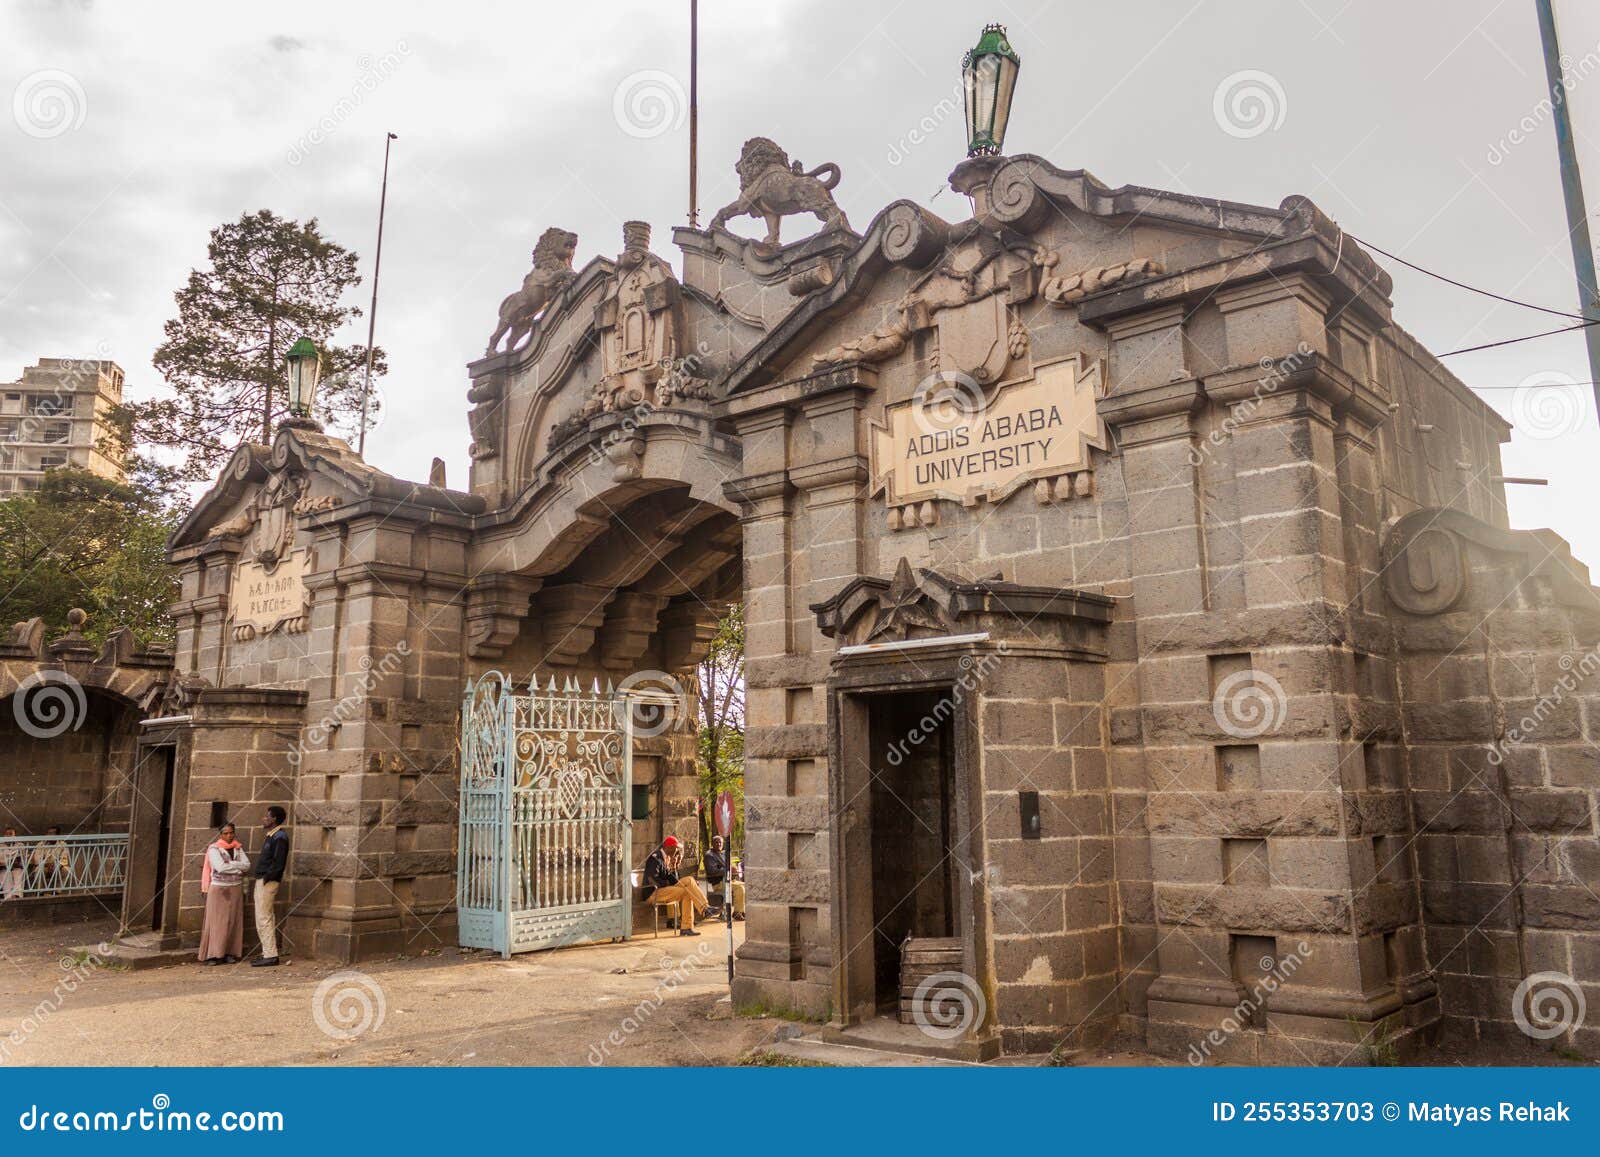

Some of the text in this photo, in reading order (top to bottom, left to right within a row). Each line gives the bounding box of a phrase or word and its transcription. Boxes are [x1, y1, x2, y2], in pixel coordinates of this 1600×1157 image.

[906, 405, 1063, 460] ADDIS ABABA
[915, 437, 1054, 485] UNIVERSITY
